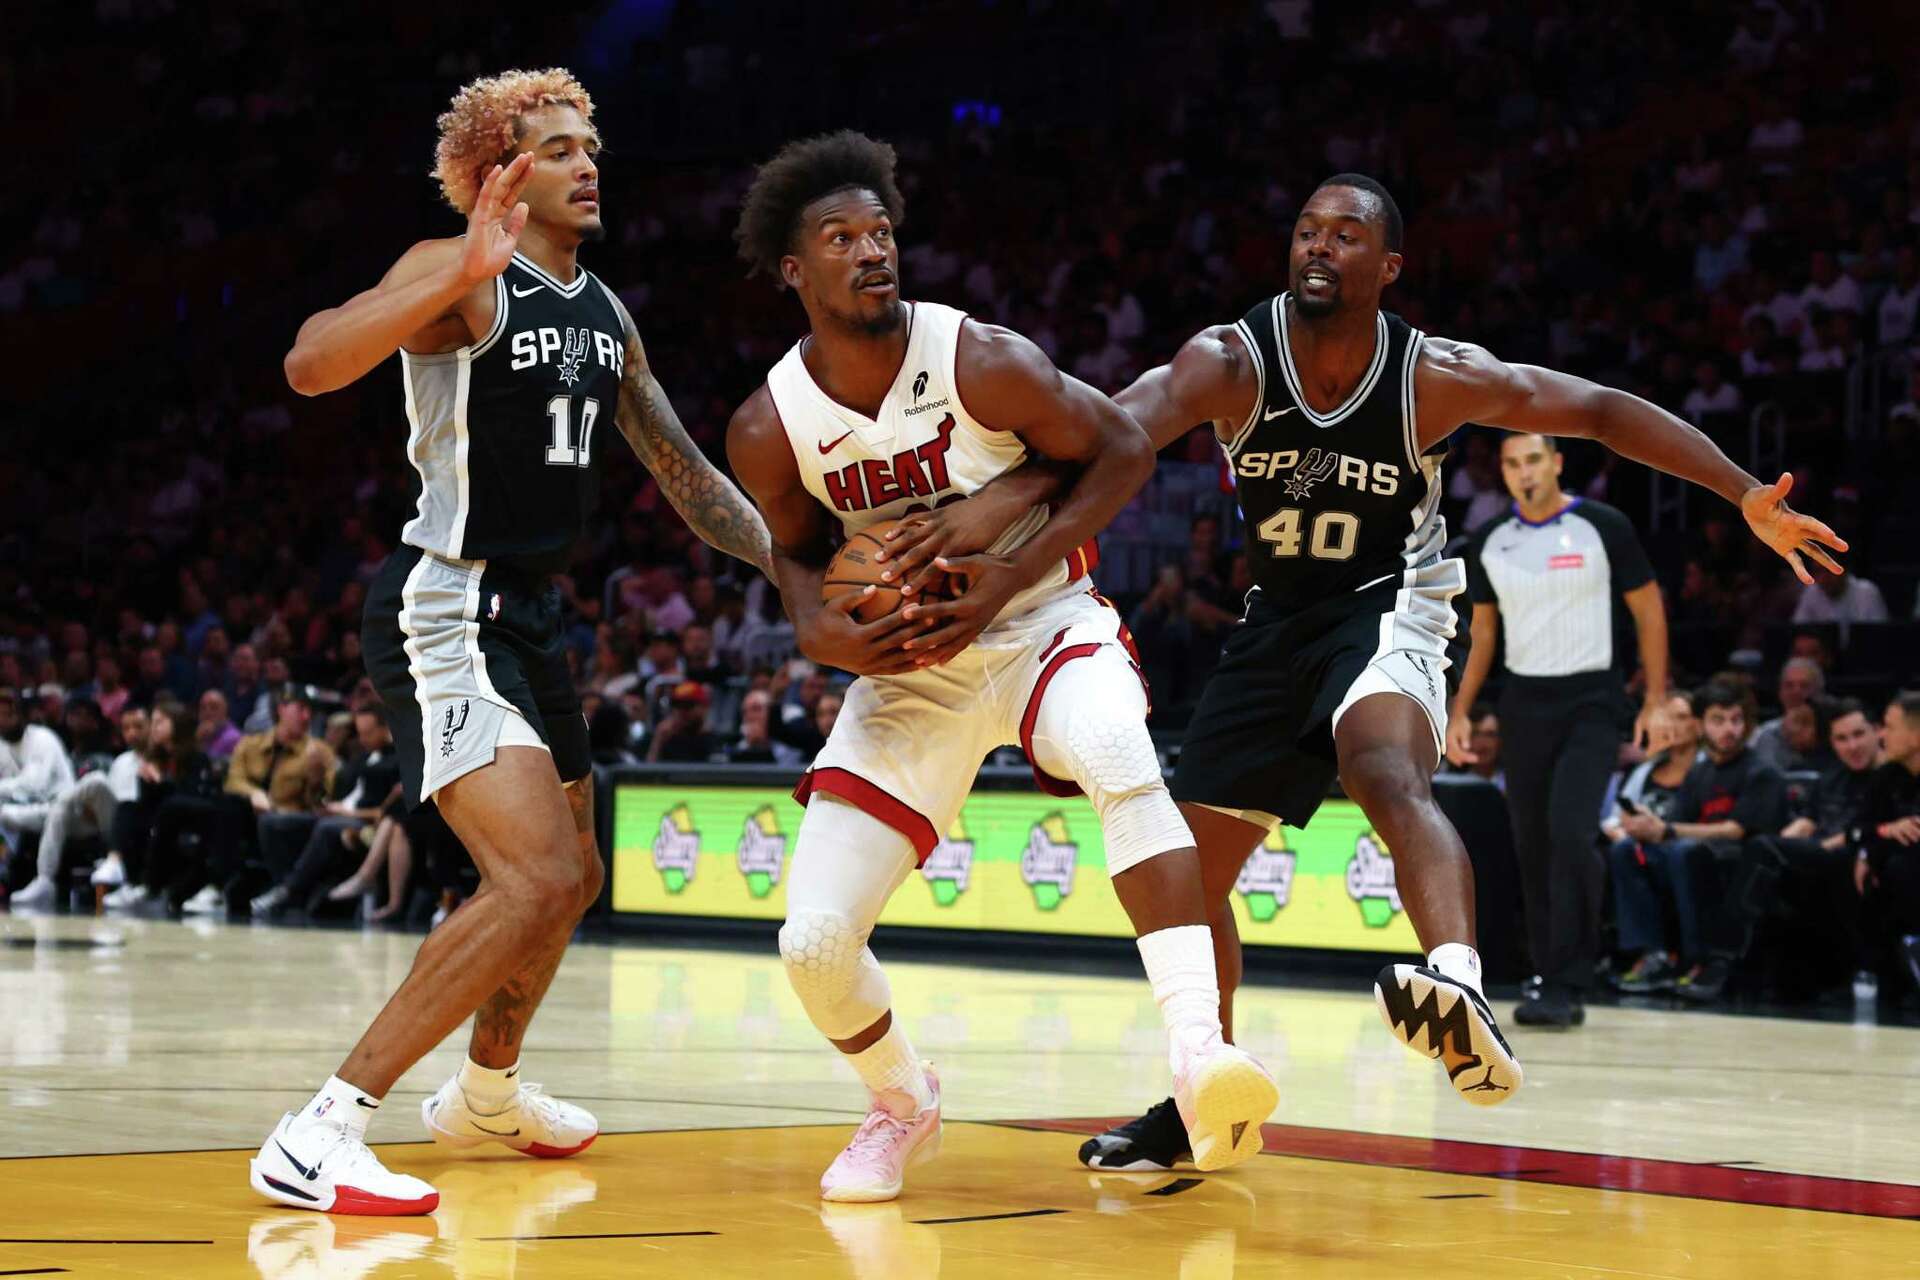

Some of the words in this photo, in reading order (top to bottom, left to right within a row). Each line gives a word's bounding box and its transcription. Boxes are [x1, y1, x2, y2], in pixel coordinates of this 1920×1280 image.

[511, 327, 624, 388] SPURS
[904, 398, 949, 417] Robinhood
[823, 412, 956, 512] HEAT
[1238, 448, 1400, 501] SPURS
[1256, 507, 1361, 560] 40
